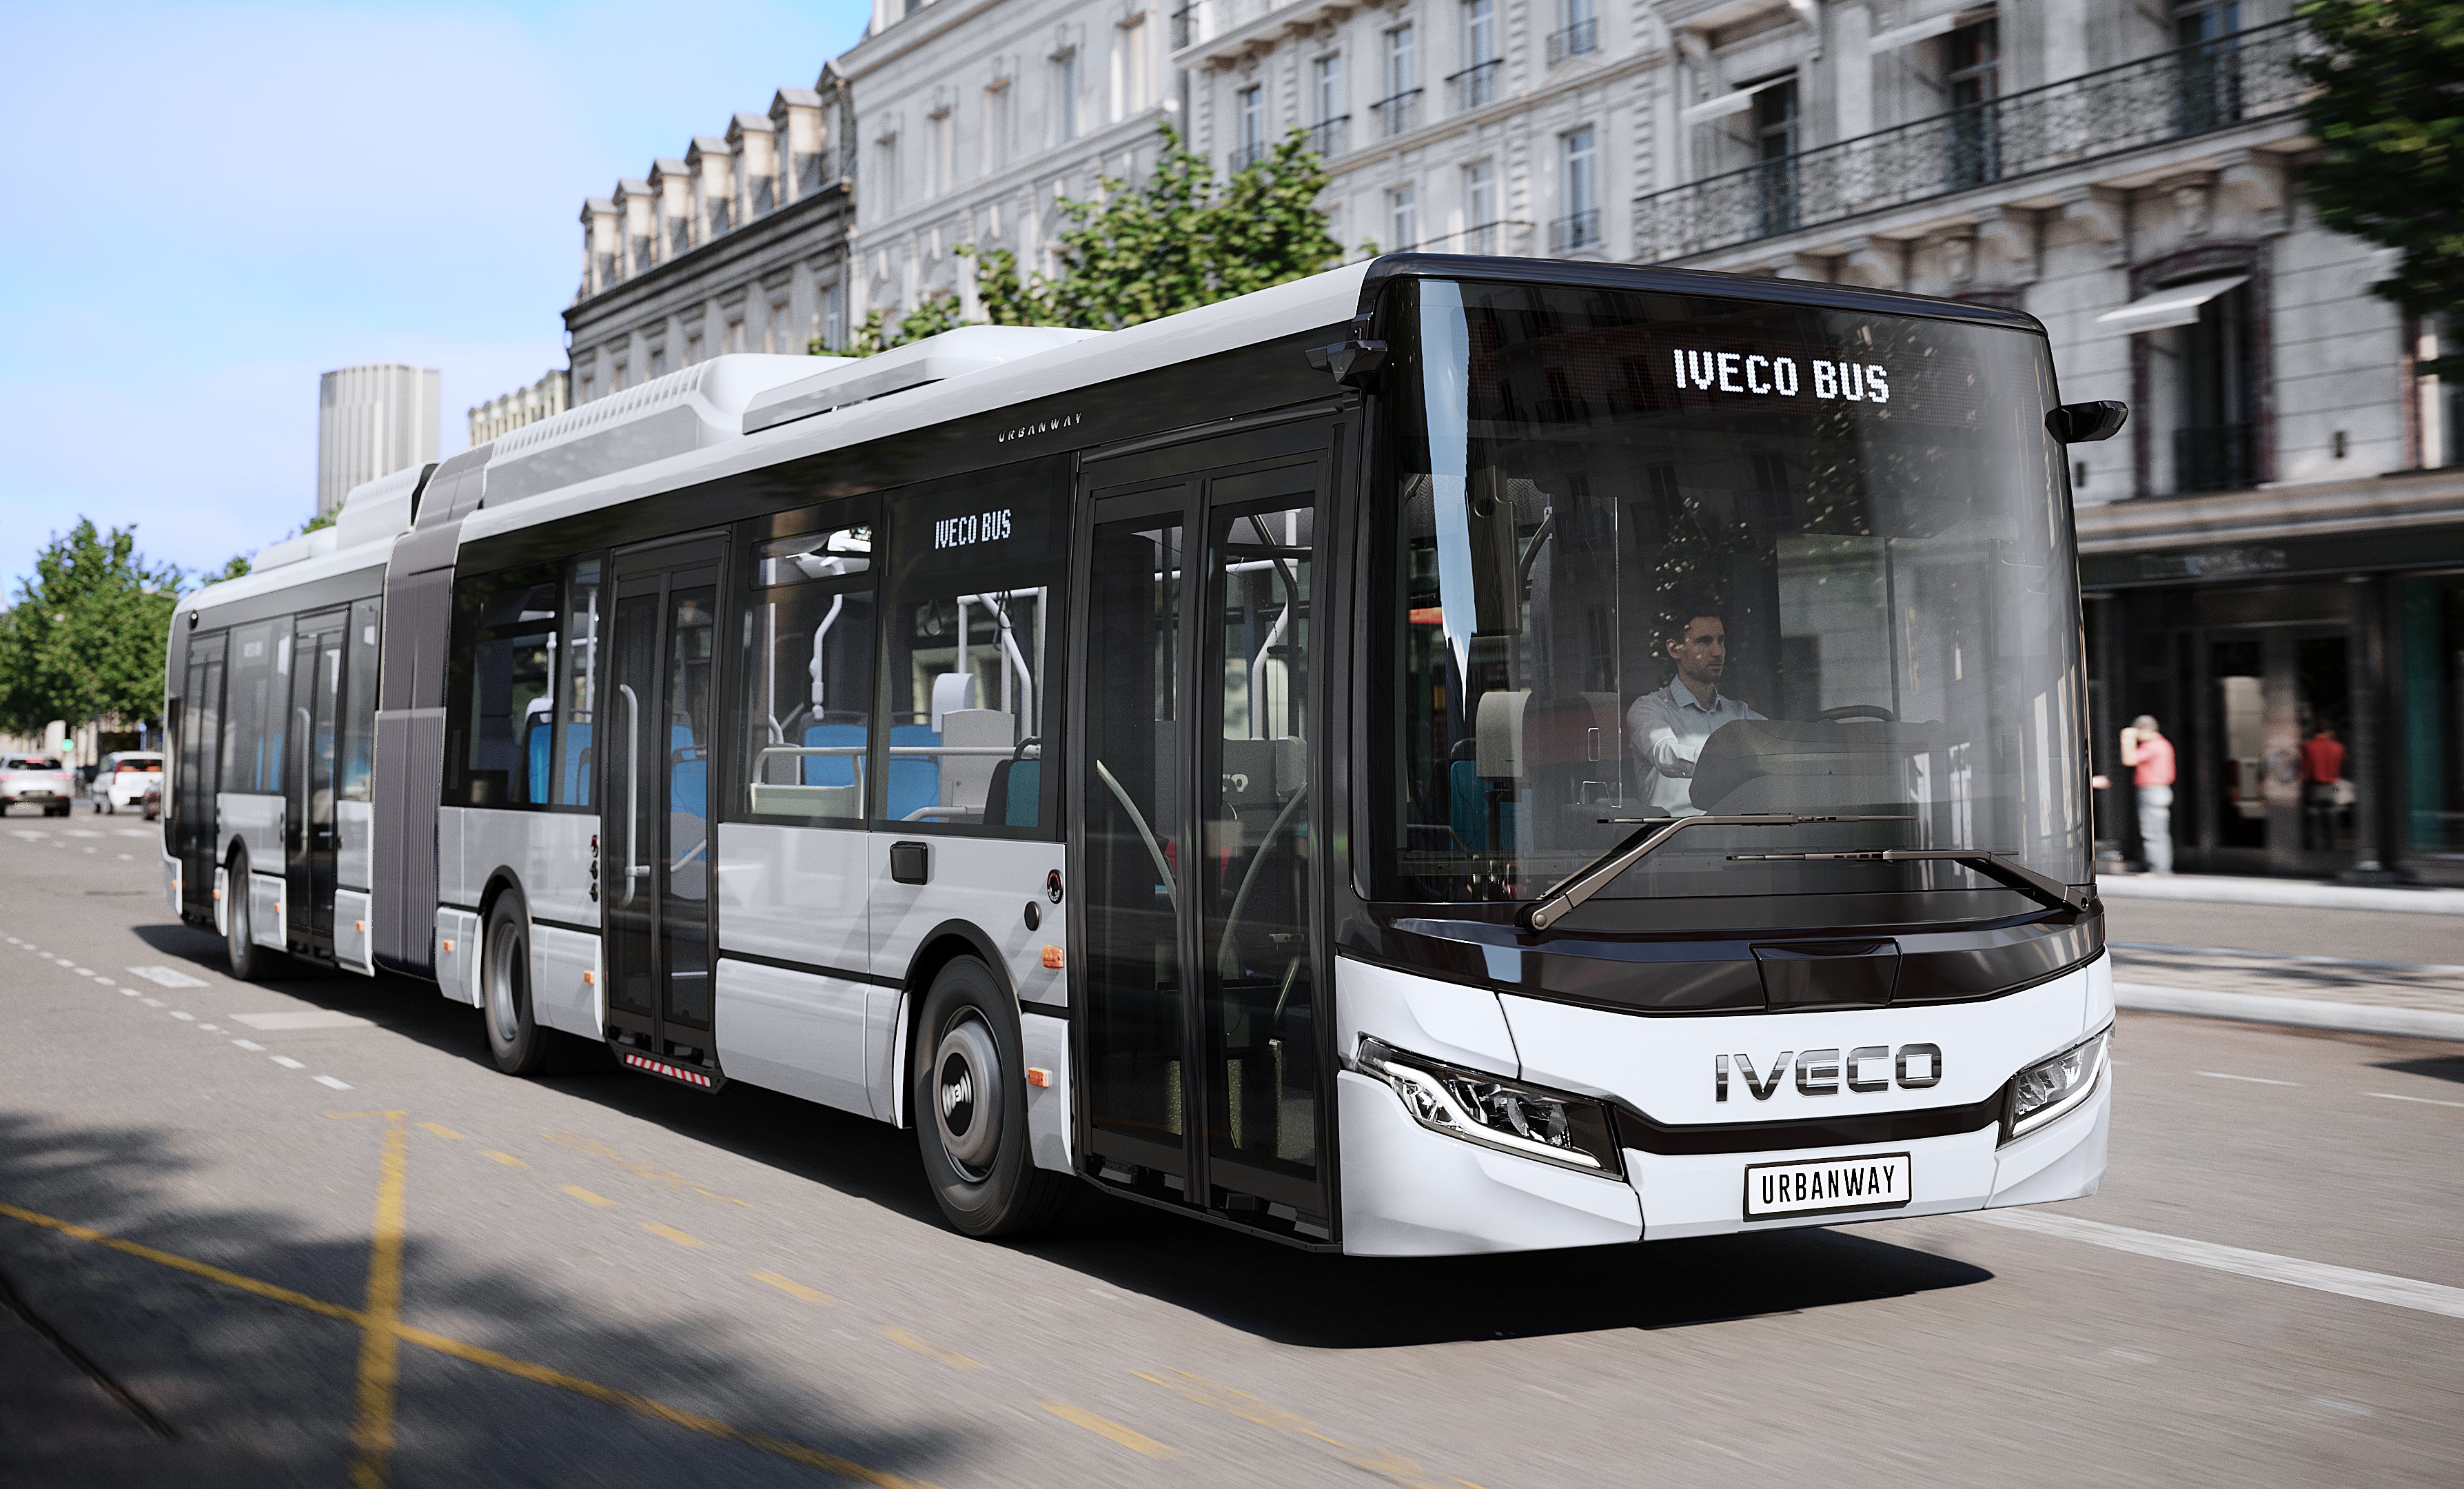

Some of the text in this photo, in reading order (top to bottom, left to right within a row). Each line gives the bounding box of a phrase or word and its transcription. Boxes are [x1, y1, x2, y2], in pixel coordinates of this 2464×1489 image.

[1673, 349, 1889, 403] IVECO BUS
[999, 412, 1082, 443] URBANWAY
[935, 509, 1011, 549] IVECO BUS
[1715, 1042, 1942, 1103] IVECO
[1762, 1165, 1895, 1204] URBANWAY
